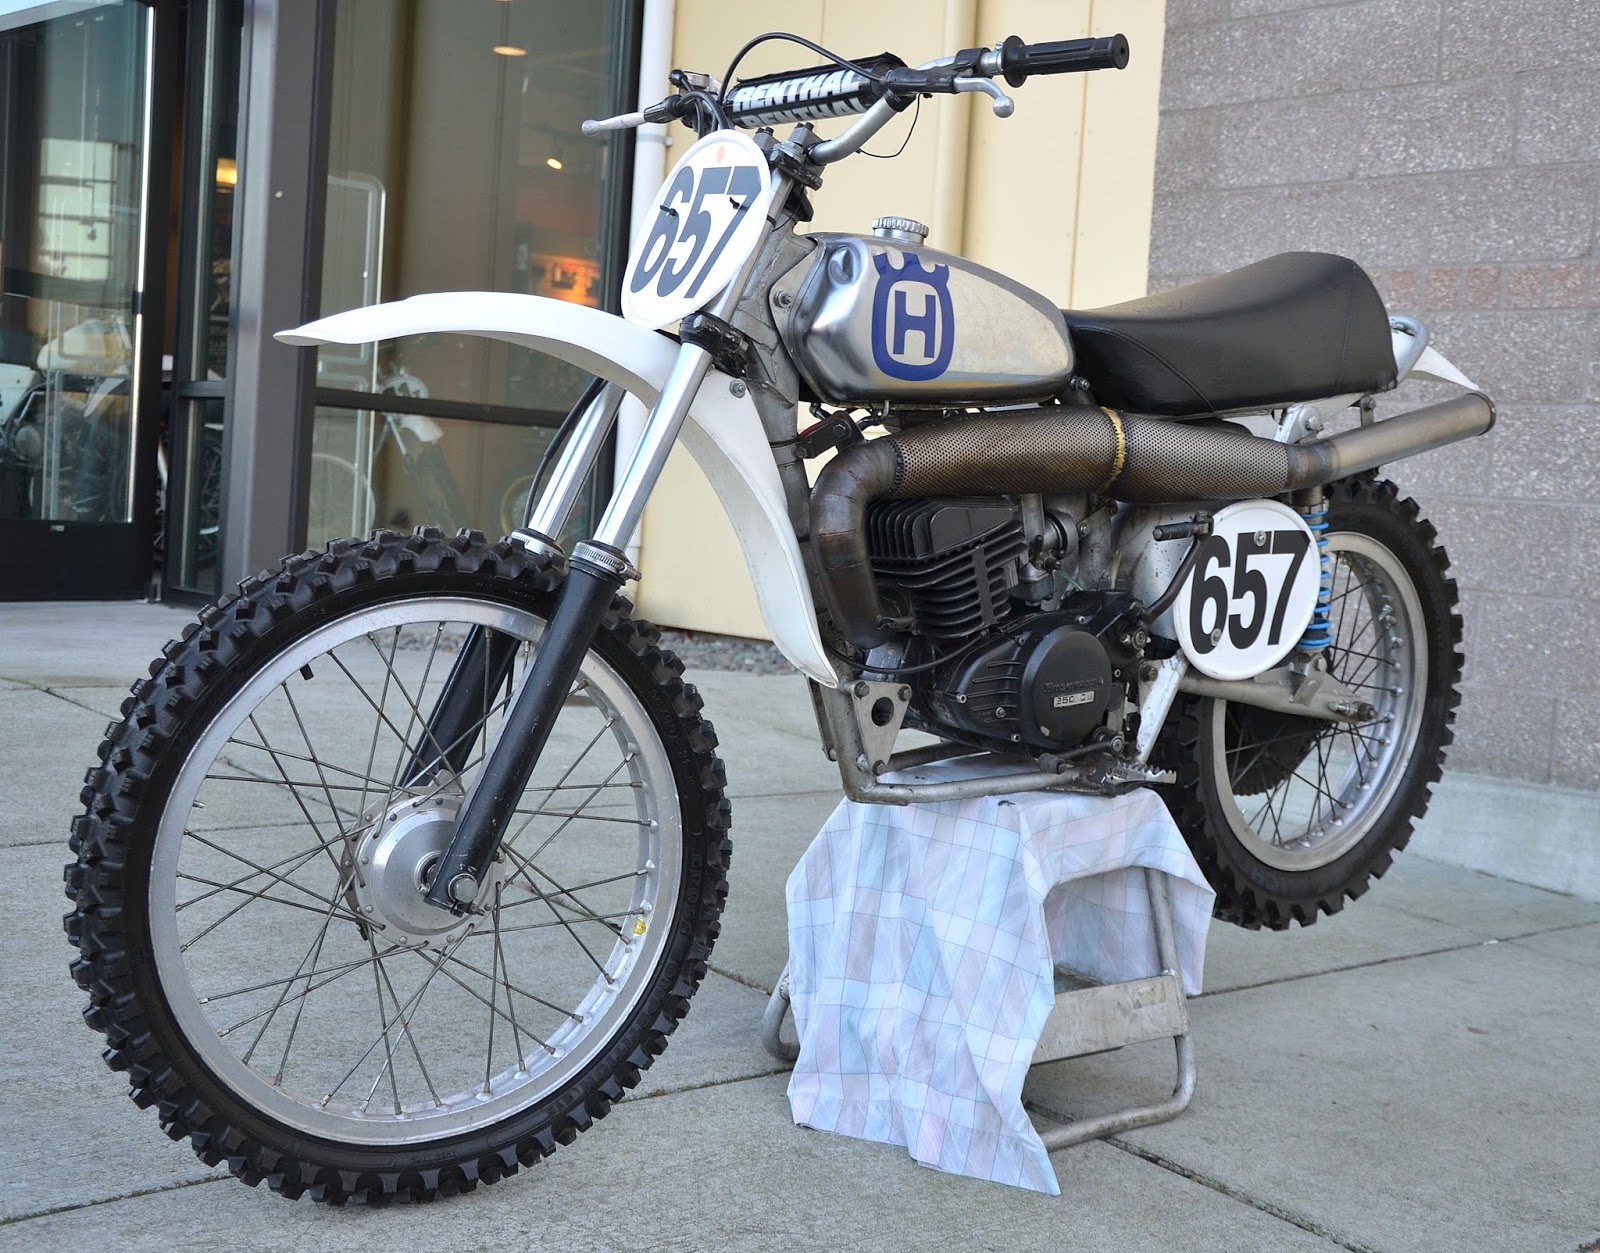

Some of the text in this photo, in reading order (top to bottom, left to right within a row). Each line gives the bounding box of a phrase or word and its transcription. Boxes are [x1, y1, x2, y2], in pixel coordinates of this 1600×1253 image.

[732, 69, 860, 112] RENTHAL
[629, 165, 763, 299] 657
[892, 289, 937, 359] H
[1189, 529, 1312, 655] 657
